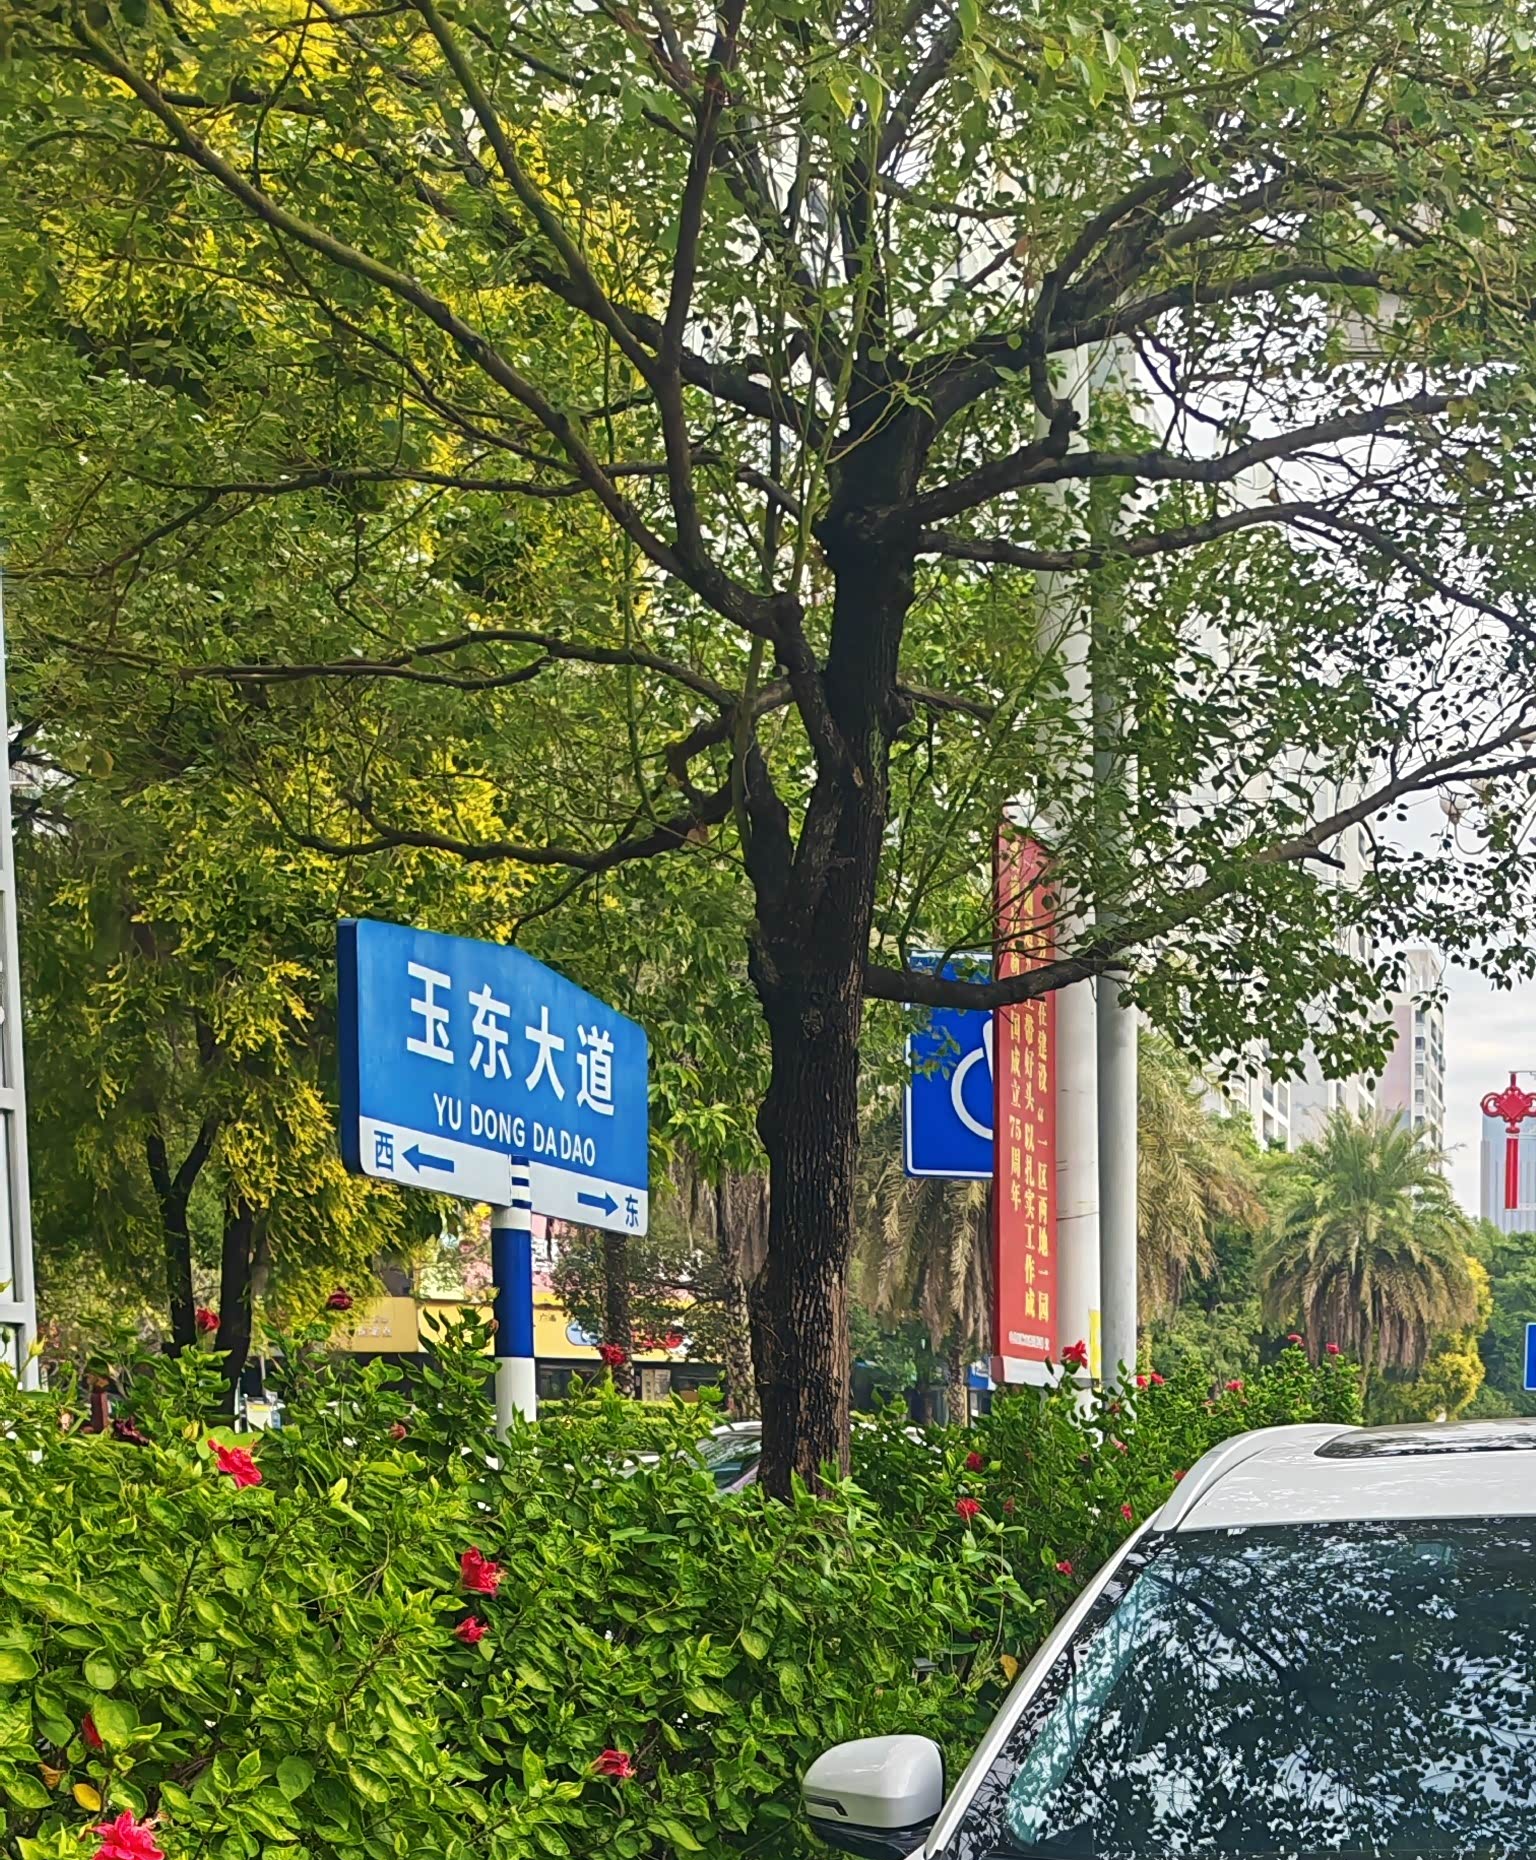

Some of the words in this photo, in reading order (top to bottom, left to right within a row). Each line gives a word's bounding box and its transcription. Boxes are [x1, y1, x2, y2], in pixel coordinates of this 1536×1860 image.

[406, 961, 615, 1116] 玉东大道
[373, 1129, 395, 1173] 西
[433, 1093, 463, 1131] YU
[470, 1103, 525, 1148] DONG
[533, 1121, 557, 1159] DA
[560, 1130, 596, 1168] DAO
[624, 1193, 640, 1228] 东
